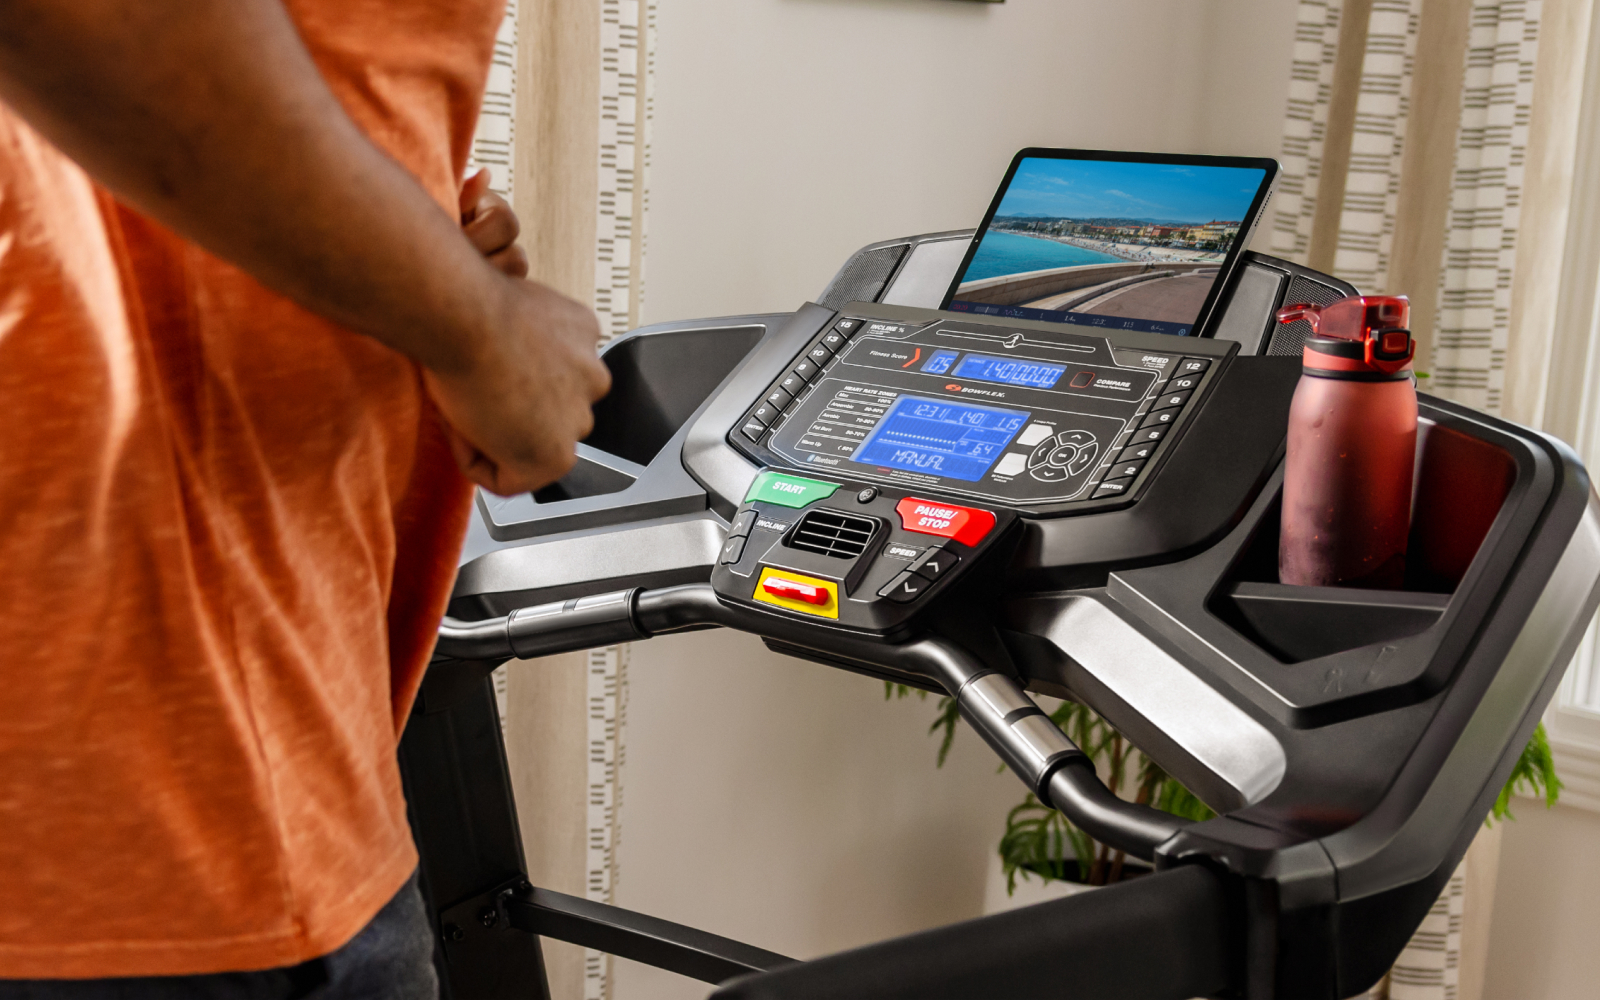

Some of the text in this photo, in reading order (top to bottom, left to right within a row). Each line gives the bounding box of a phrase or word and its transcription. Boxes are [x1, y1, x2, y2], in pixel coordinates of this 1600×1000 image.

[839, 320, 852, 329] 15
[870, 323, 898, 332] INCLINE
[826, 335, 839, 343] 13
[812, 349, 825, 357] 10
[869, 350, 908, 360] Fitness Score
[1141, 355, 1169, 364] SPEED
[797, 363, 807, 371] 8
[1185, 362, 1201, 370] 12
[1096, 378, 1131, 388] COMPARE
[1176, 379, 1192, 387] 10
[769, 393, 780, 401] 2
[961, 387, 1002, 398] BOWFLEX
[1169, 396, 1181, 404] 8
[822, 412, 840, 420] Aerobic
[745, 423, 764, 431] ENTER
[998, 417, 1022, 430] 115
[1148, 431, 1160, 439] 5
[1137, 449, 1148, 457] 4
[813, 455, 839, 466] Bluetooth
[890, 449, 945, 471] MANUAL
[1124, 466, 1137, 475] 2
[772, 482, 807, 495] START
[914, 505, 958, 519] PAUSE/
[756, 519, 787, 531] INCLINE
[918, 517, 951, 529] STOP
[889, 547, 917, 557] SPEED
